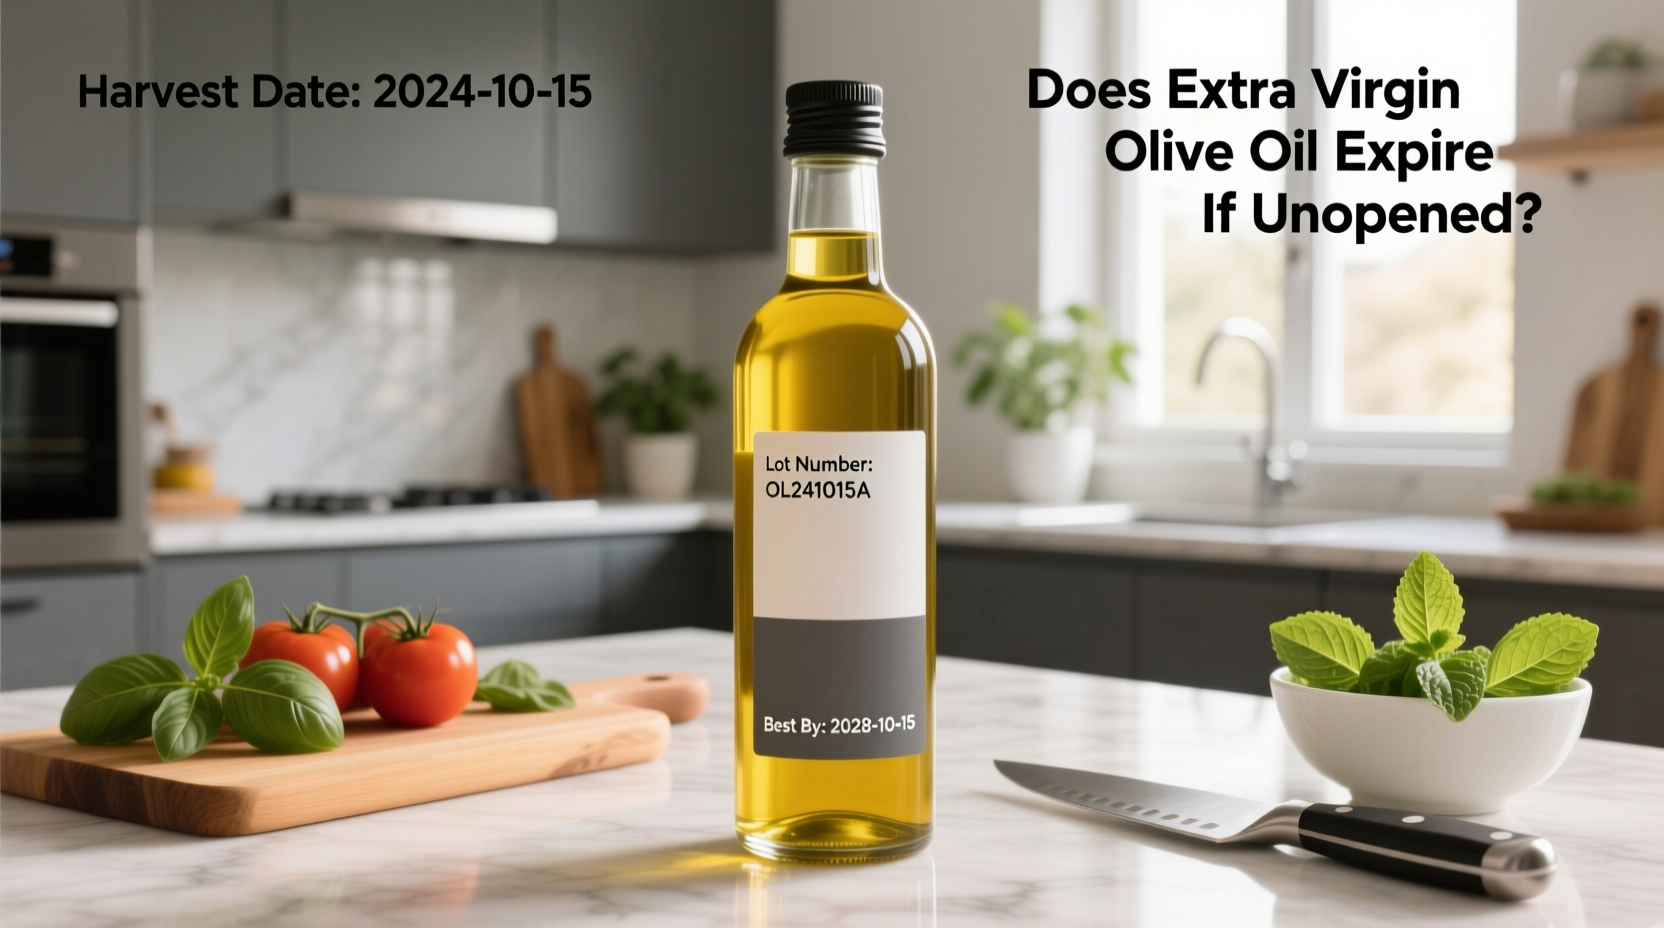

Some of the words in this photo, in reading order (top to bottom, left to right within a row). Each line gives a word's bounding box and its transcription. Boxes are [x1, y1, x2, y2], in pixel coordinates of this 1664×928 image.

[766, 455, 791, 472] Lot
[795, 455, 873, 473] Number:
[765, 480, 871, 499] OL241015A
[764, 716, 797, 733] Best
[800, 717, 826, 738] By:
[830, 714, 916, 734] 2028-10-15
